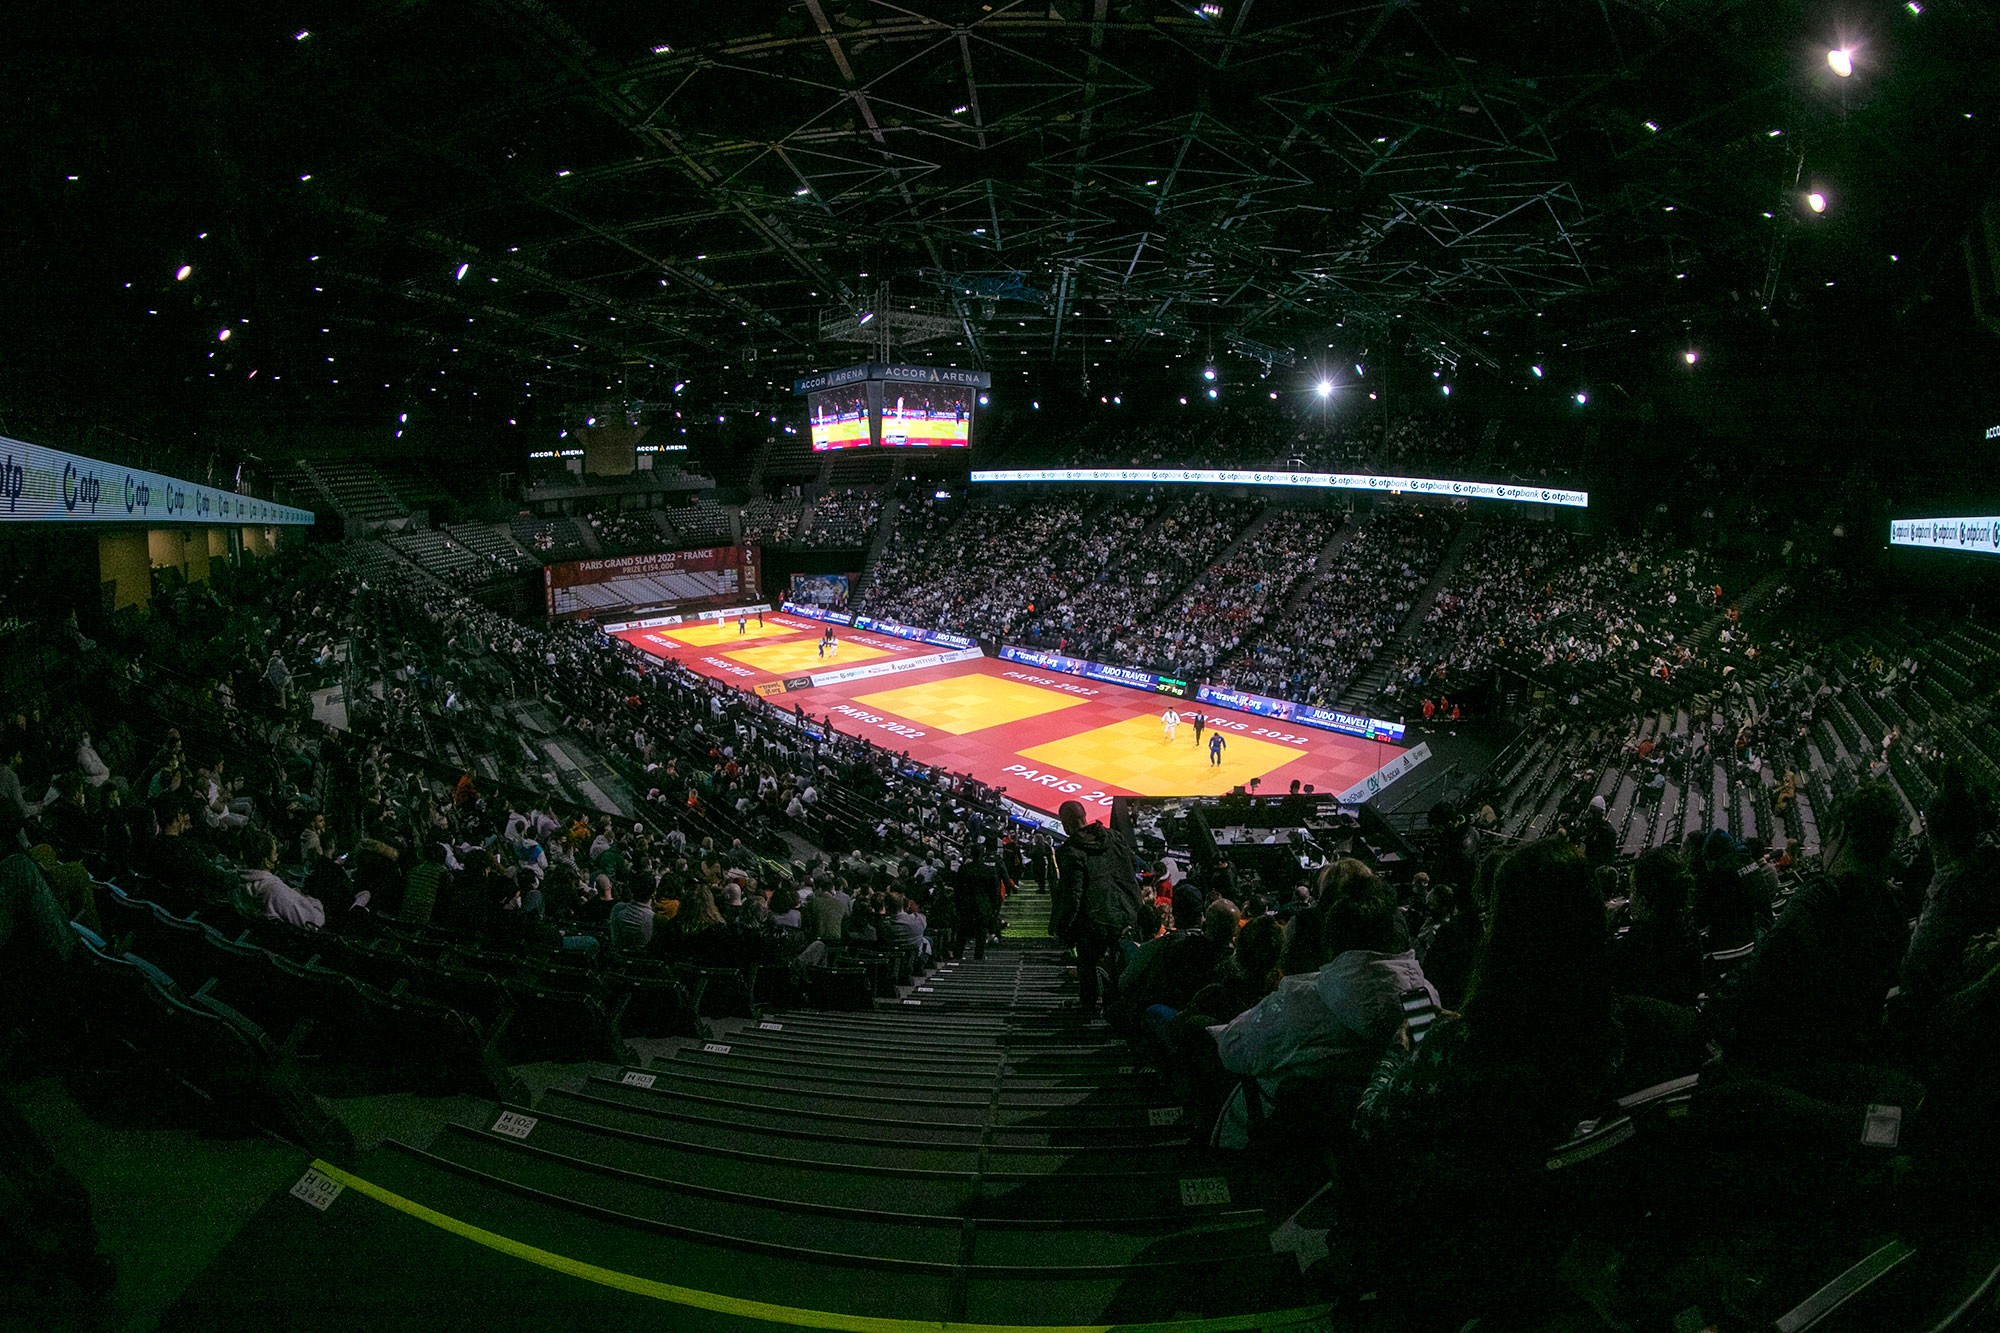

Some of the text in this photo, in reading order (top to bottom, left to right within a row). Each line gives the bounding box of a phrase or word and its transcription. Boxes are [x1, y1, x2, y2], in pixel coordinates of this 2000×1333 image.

[801, 369, 863, 390] ACCOR ARENA
[885, 368, 980, 382] ACCOR ARENA
[1338, 477, 1366, 485] otpbank
[1378, 478, 1408, 488] otpbank
[1420, 481, 1450, 490] otpbank
[1463, 484, 1494, 494] otpbank
[1507, 488, 1538, 498] otpbank
[1552, 491, 1584, 502] otpbank
[580, 550, 713, 570] PARIS GRAND SLAM 2022 FRANCE
[611, 573, 646, 581] INTERNATIONAL
[622, 566, 640, 574] PRIZE
[700, 656, 755, 676] PARIS 2022
[1102, 666, 1120, 676] JUDO
[1002, 672, 1098, 695] PARIS 2022
[1172, 686, 1184, 696] kg
[830, 705, 925, 739] PARIS 2022
[1312, 710, 1335, 721] JUDO
[1251, 728, 1308, 744] 2022
[1002, 764, 1082, 793] PARIS
[1387, 768, 1400, 781] SOCAR
[514, 1117, 533, 1128] 102
[305, 1173, 318, 1184] H
